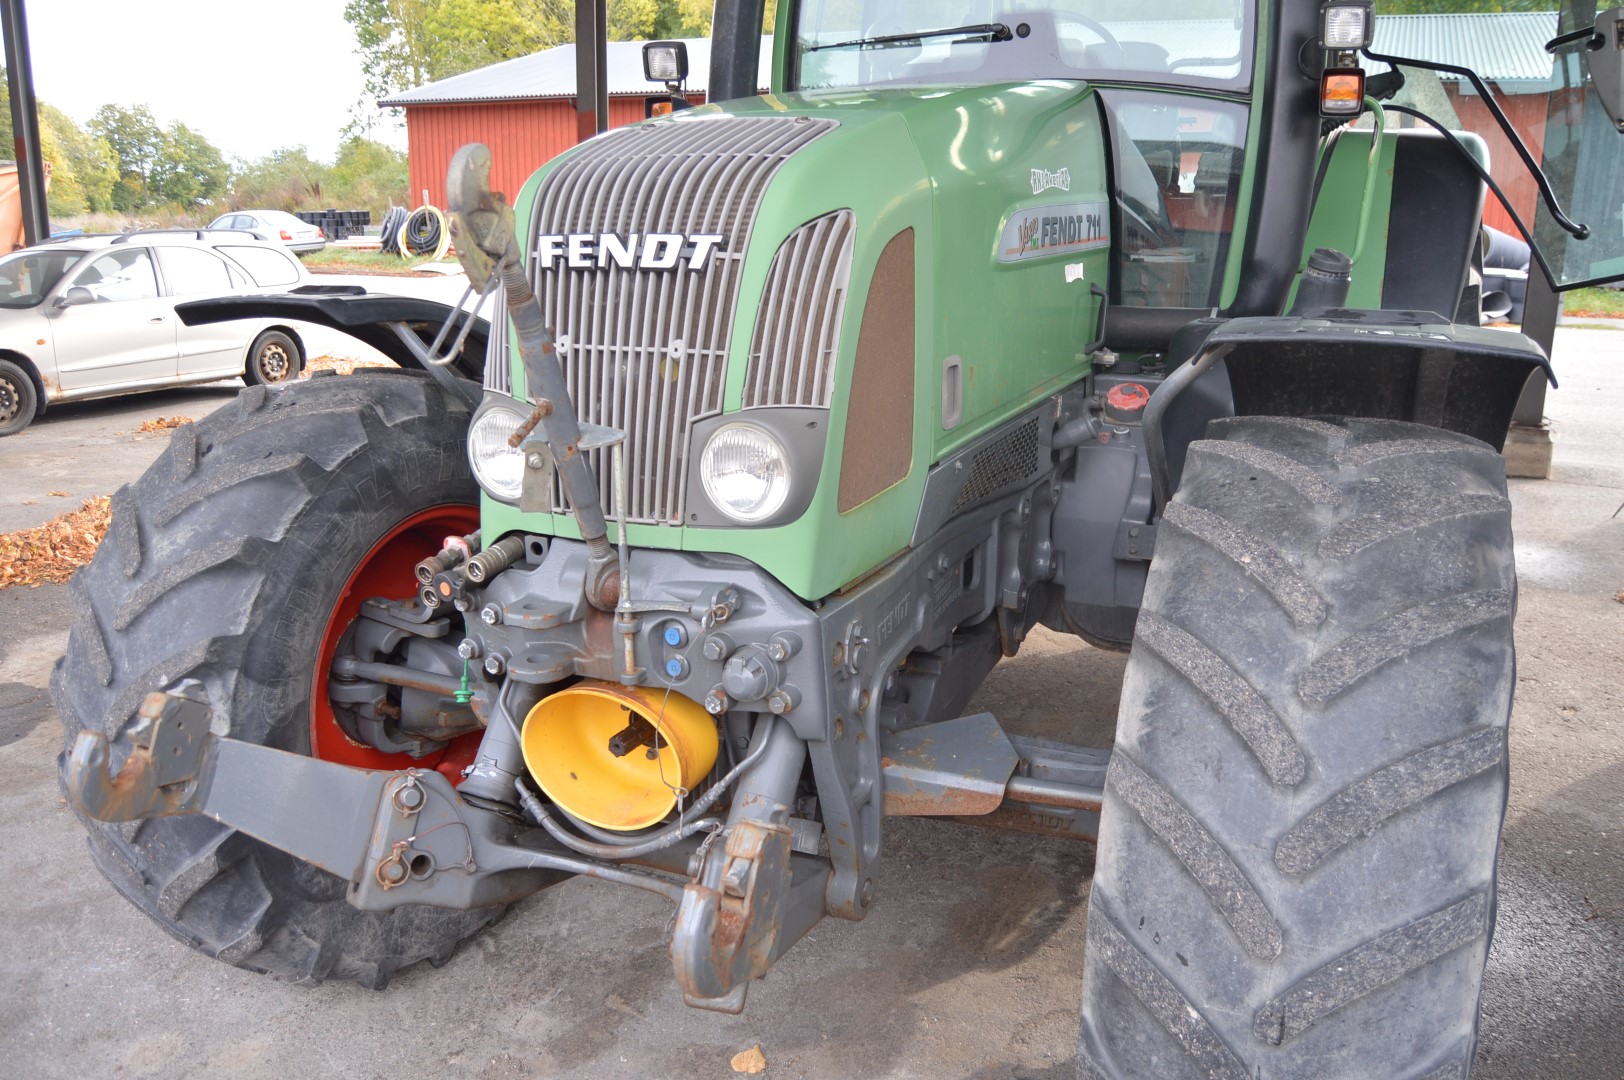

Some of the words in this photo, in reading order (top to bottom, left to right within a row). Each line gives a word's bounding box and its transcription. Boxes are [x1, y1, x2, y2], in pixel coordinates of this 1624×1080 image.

[1041, 215, 1083, 247] FENDT
[1086, 214, 1101, 241] 711
[538, 233, 724, 271] FENDT
